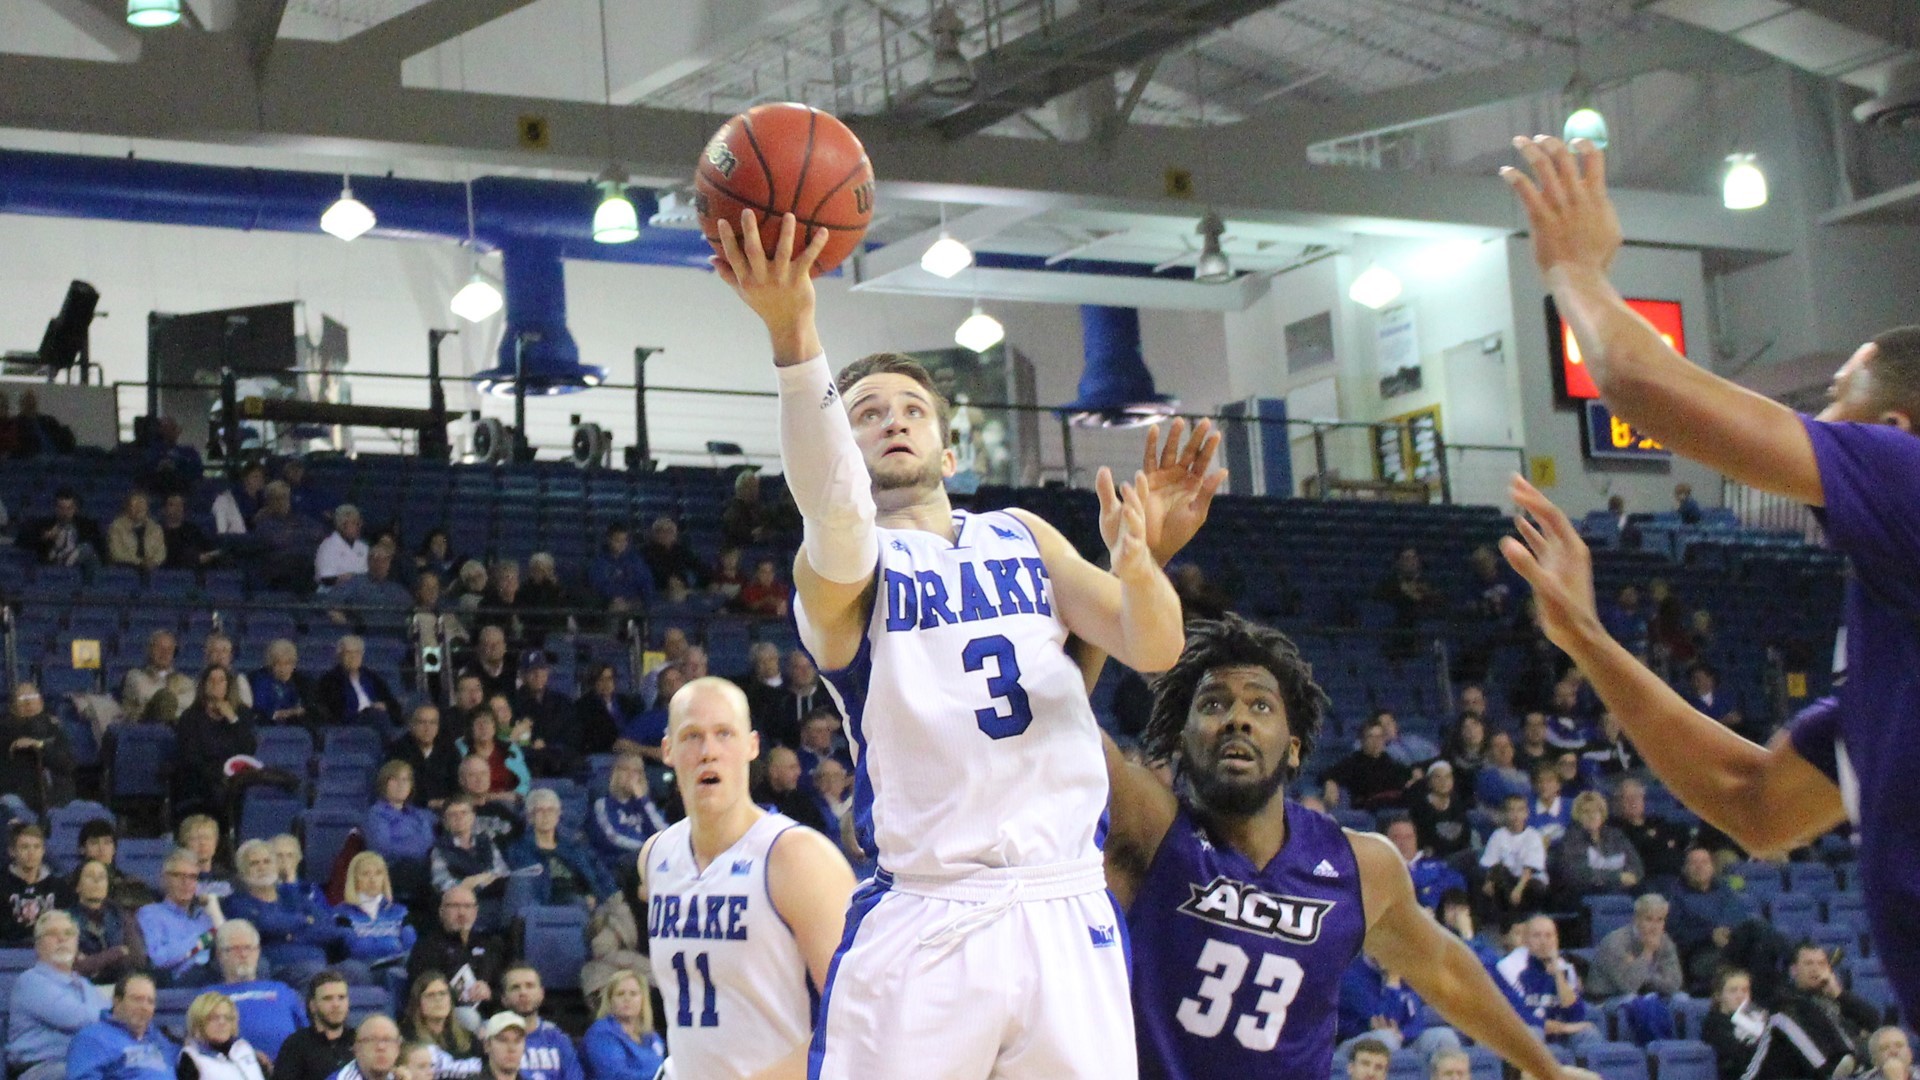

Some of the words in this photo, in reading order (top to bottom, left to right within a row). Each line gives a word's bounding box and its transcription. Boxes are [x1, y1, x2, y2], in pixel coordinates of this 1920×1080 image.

[885, 557, 1051, 632] DRAKE
[962, 634, 1033, 740] 3
[650, 895, 748, 940] DRAKE
[1195, 884, 1318, 937] ACU
[672, 952, 719, 1027] 11
[1176, 938, 1304, 1052] 33
